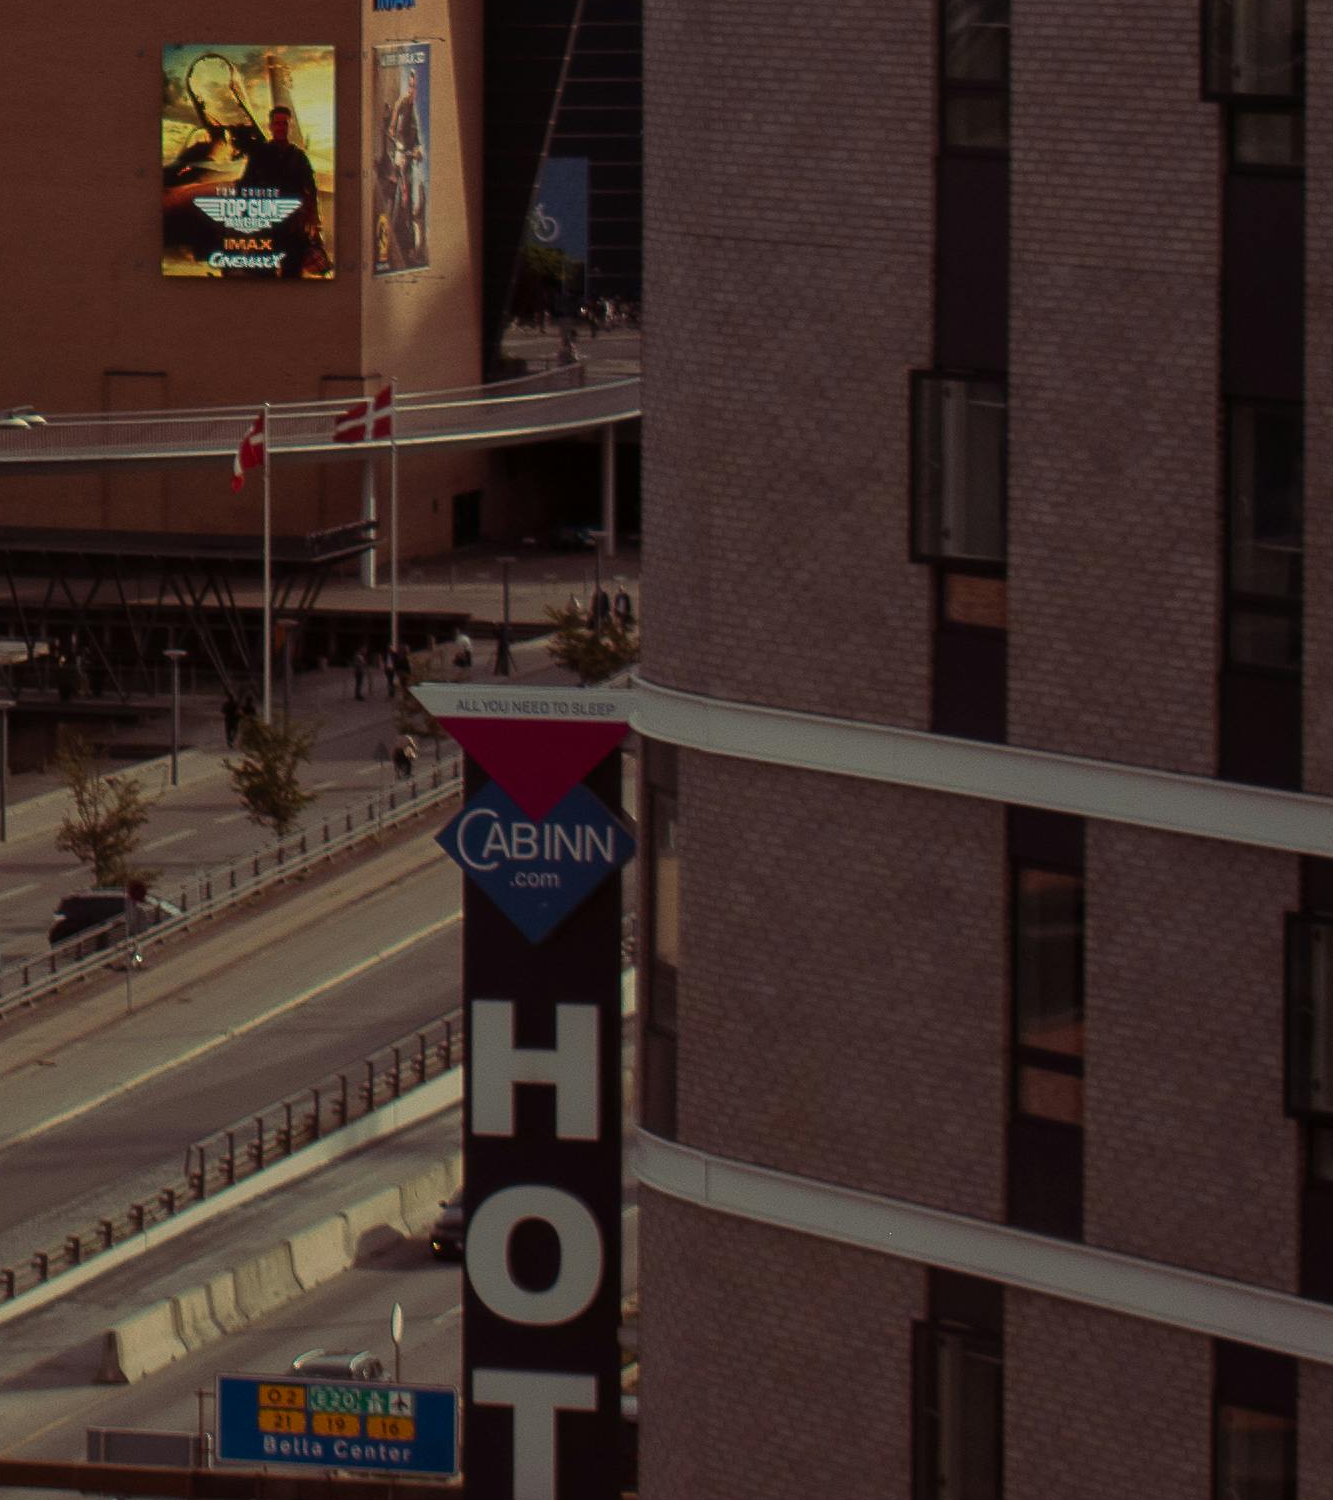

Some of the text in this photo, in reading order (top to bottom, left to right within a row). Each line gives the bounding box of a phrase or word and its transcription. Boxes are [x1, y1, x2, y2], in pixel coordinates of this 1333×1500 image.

[220, 199, 278, 217] TOP GUN
[224, 239, 273, 250] IMAX
[456, 699, 616, 716] ALL YOU NEED TO SLEEP
[456, 807, 614, 872] CABINN
[273, 1414, 400, 1436] 21 19 16
[263, 1435, 413, 1462] Bella Center
